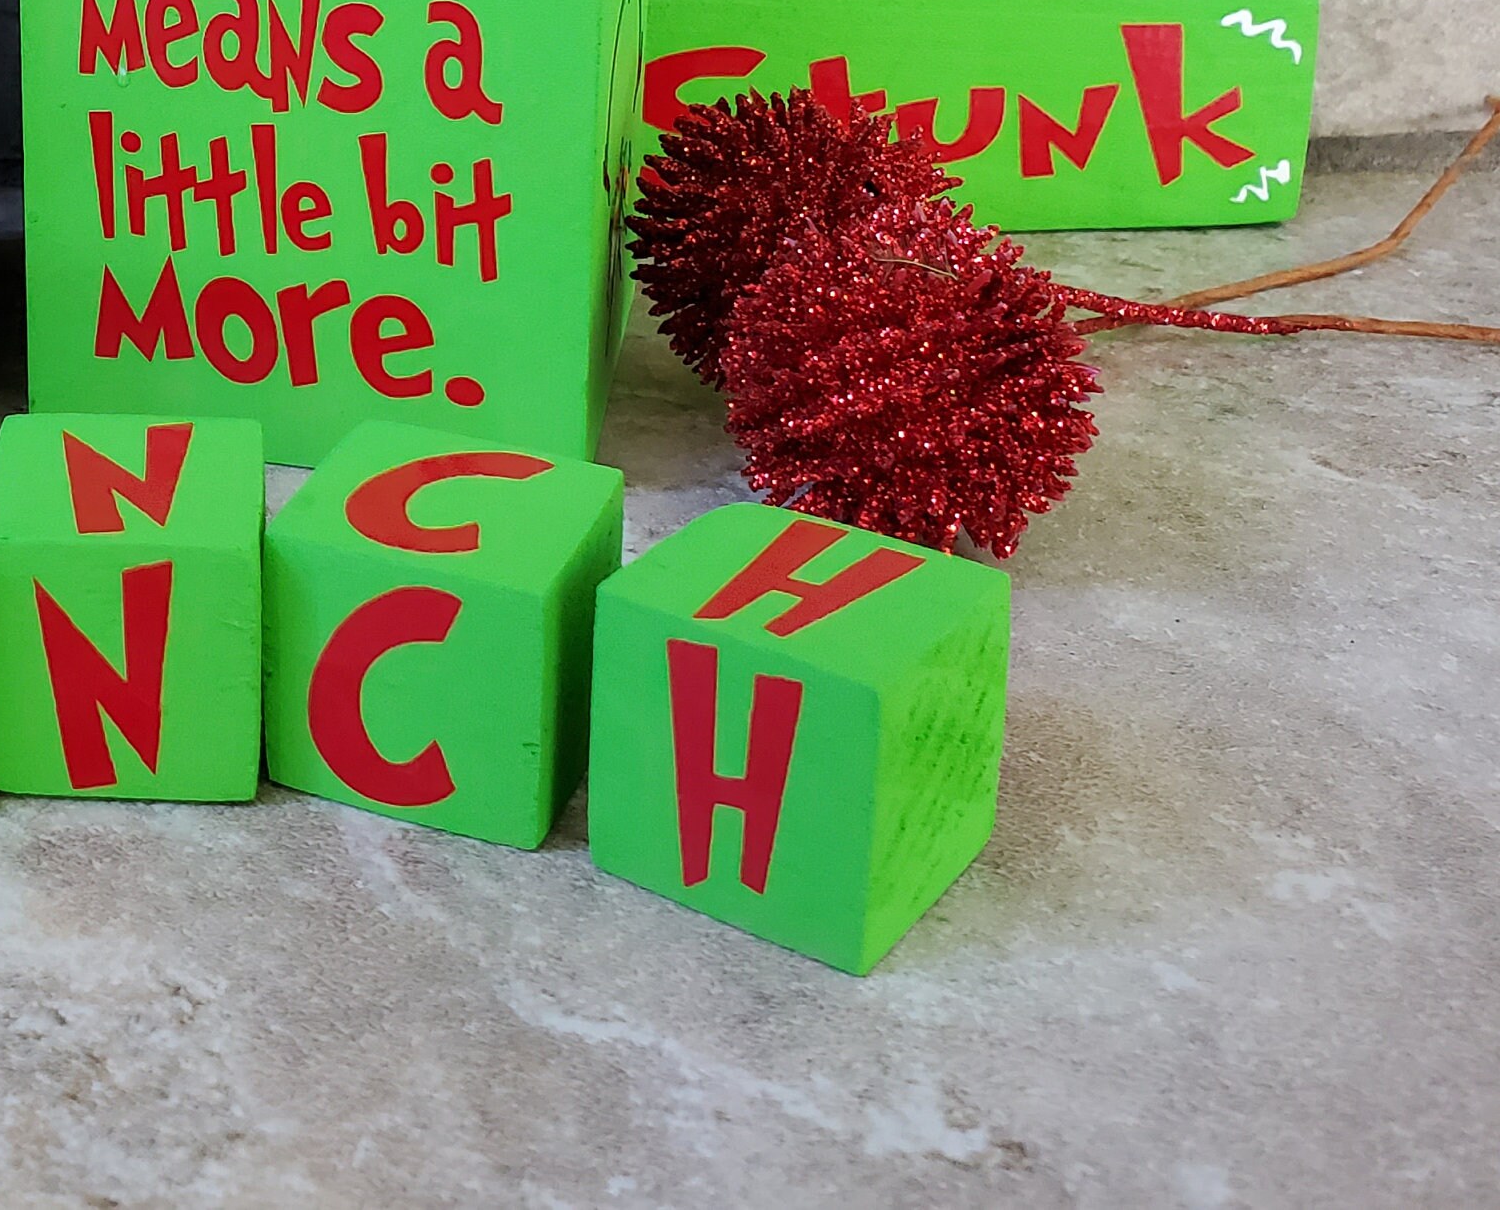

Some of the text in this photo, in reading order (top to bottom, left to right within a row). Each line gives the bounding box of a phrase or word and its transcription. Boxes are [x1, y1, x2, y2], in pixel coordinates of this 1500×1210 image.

[425, 0, 503, 125] a
[88, 110, 512, 282] little bit
